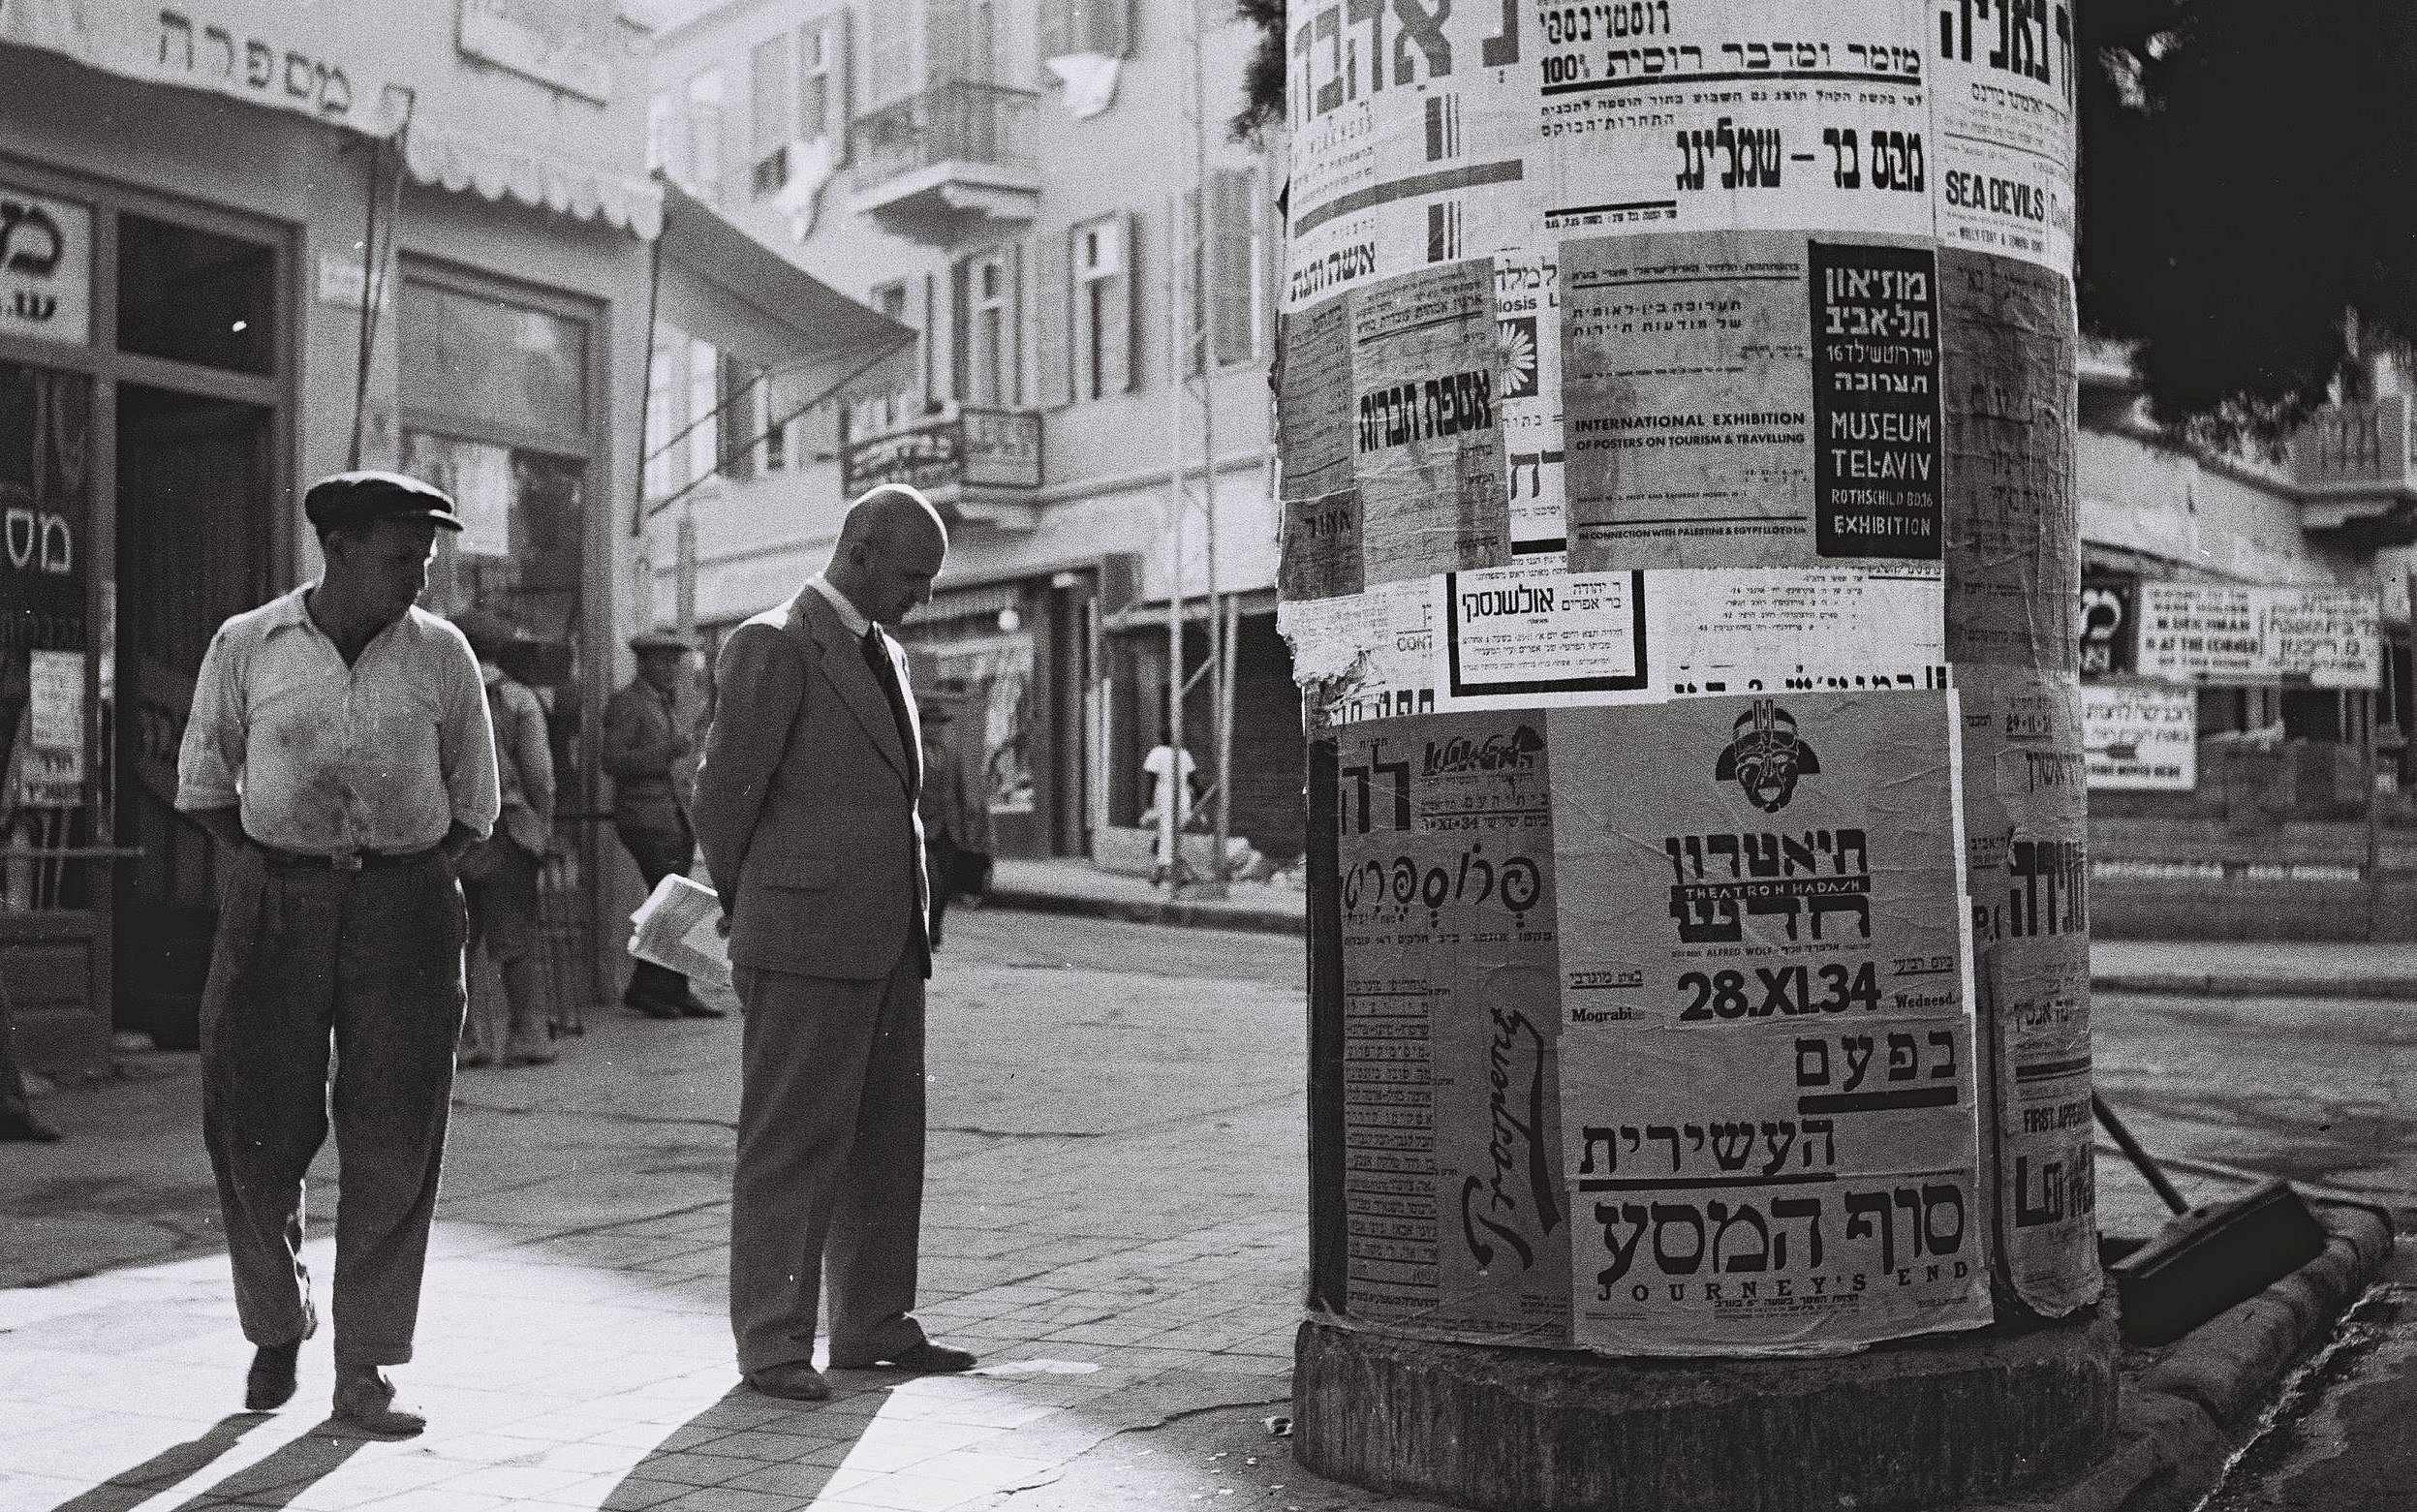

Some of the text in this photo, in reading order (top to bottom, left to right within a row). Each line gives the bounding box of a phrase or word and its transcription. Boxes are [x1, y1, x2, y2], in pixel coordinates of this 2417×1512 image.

[157, 9, 353, 115] מספרה
[1541, 42, 1922, 84] מזמר ומדבר רוסית 100%
[1540, 98, 1591, 116] לתכנית
[1596, 96, 1642, 109] הוספה
[1652, 93, 1685, 106] בתור
[1692, 92, 1742, 104] השבוע
[1751, 91, 1768, 103] גם
[1774, 90, 1808, 103] תוצג
[1816, 90, 1851, 103] הקהל
[1858, 93, 1895, 106] בקשת
[1676, 115, 1782, 192] שמלינג
[1823, 127, 1860, 189] בר
[1871, 130, 1925, 193] מקס
[1944, 169, 1986, 211] SEA
[1989, 176, 2044, 223] DEVILS
[1825, 266, 1928, 305] מוזיאון
[1672, 300, 1742, 313] תערוכה
[1572, 317, 1743, 337] של מודעות תיירות
[1826, 344, 1844, 363] 16
[1844, 339, 1910, 366] רוטשילד
[1834, 370, 1929, 395] תערוכה
[1424, 368, 1493, 440] אספת
[1574, 413, 1706, 433] INTERNATIONAL
[1712, 412, 1806, 427] EXHIBITION
[1831, 411, 1932, 445] MUSEUM
[1575, 432, 1805, 451] OF POSTERS ON TOURISM & TRAVELLING
[1831, 448, 1932, 481] TEL-AVIV
[1831, 488, 1905, 507] ROTHSCHILD
[1590, 529, 1652, 540] CONNECTION
[1653, 528, 1677, 539] WITH
[1678, 527, 1724, 537] PALESTINE
[1734, 526, 1762, 536] EGYPT
[1834, 514, 1932, 537] EXHIBITION
[1572, 582, 1608, 596] יהודה
[1462, 582, 1555, 624] אולשנסקי
[1561, 598, 1600, 612] אפרים
[1665, 828, 1869, 883] תיאטרון
[1685, 879, 1861, 900] THEATRON HADASH
[1668, 893, 1871, 943] חדש
[1706, 945, 1742, 958] ALFRED
[1746, 944, 1773, 957] WOLF
[1893, 955, 1954, 972] ביום רביעי
[1569, 972, 1618, 986] מוגרבי
[1678, 960, 1882, 1022] 28.XI.34
[1894, 992, 1956, 1009] Wednesd.
[1571, 1006, 1632, 1023] Mograbi
[1795, 1031, 1957, 1093] בפעם
[2024, 1106, 2055, 1133] FIRST
[1460, 1006, 1564, 1271] Prosperity
[1579, 1118, 1836, 1177] העשירית
[1595, 1182, 1965, 1286] סוף המסע
[1597, 1261, 1968, 1302] JOURNEY'S END
